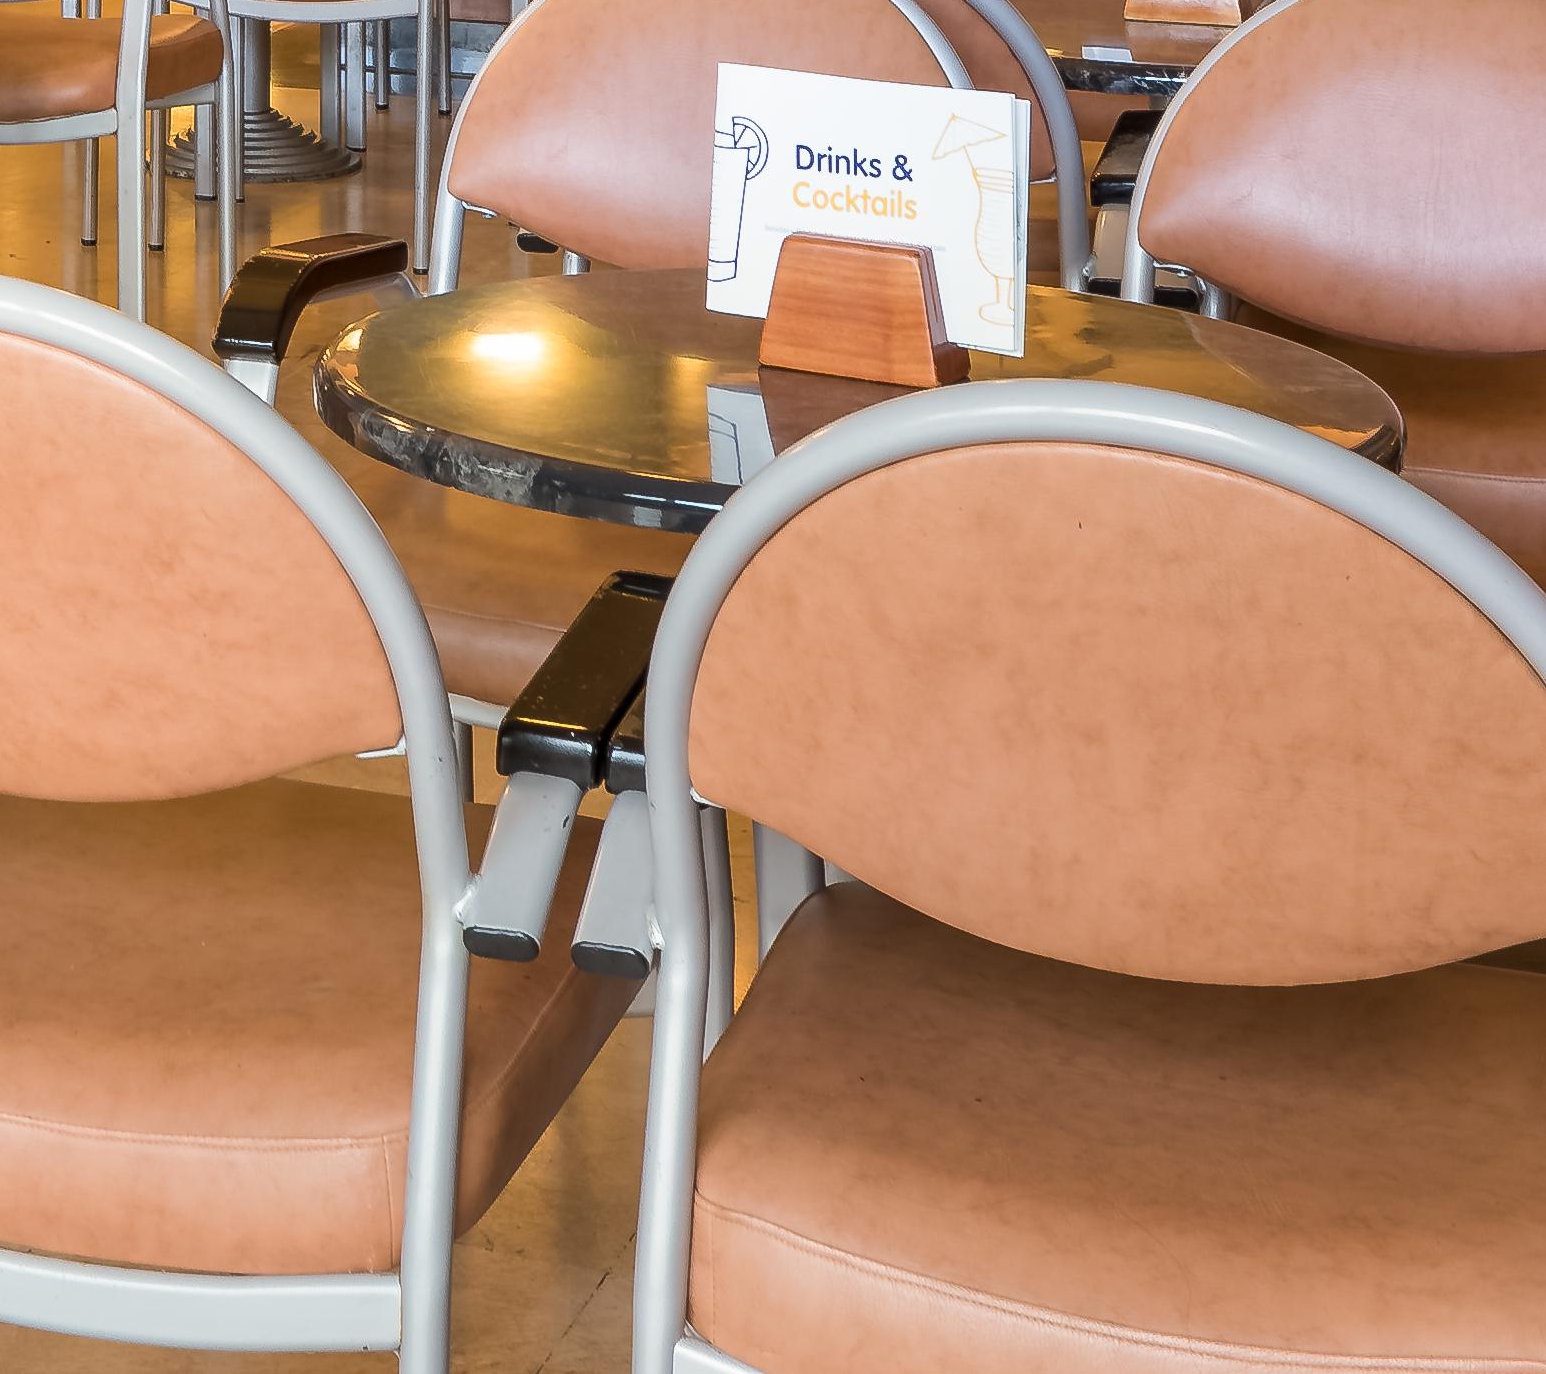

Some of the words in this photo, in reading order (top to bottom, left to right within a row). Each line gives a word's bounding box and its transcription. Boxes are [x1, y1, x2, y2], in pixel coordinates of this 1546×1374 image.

[795, 144, 882, 179] Drinks
[891, 154, 914, 182] &
[792, 181, 918, 221] Cocktails
